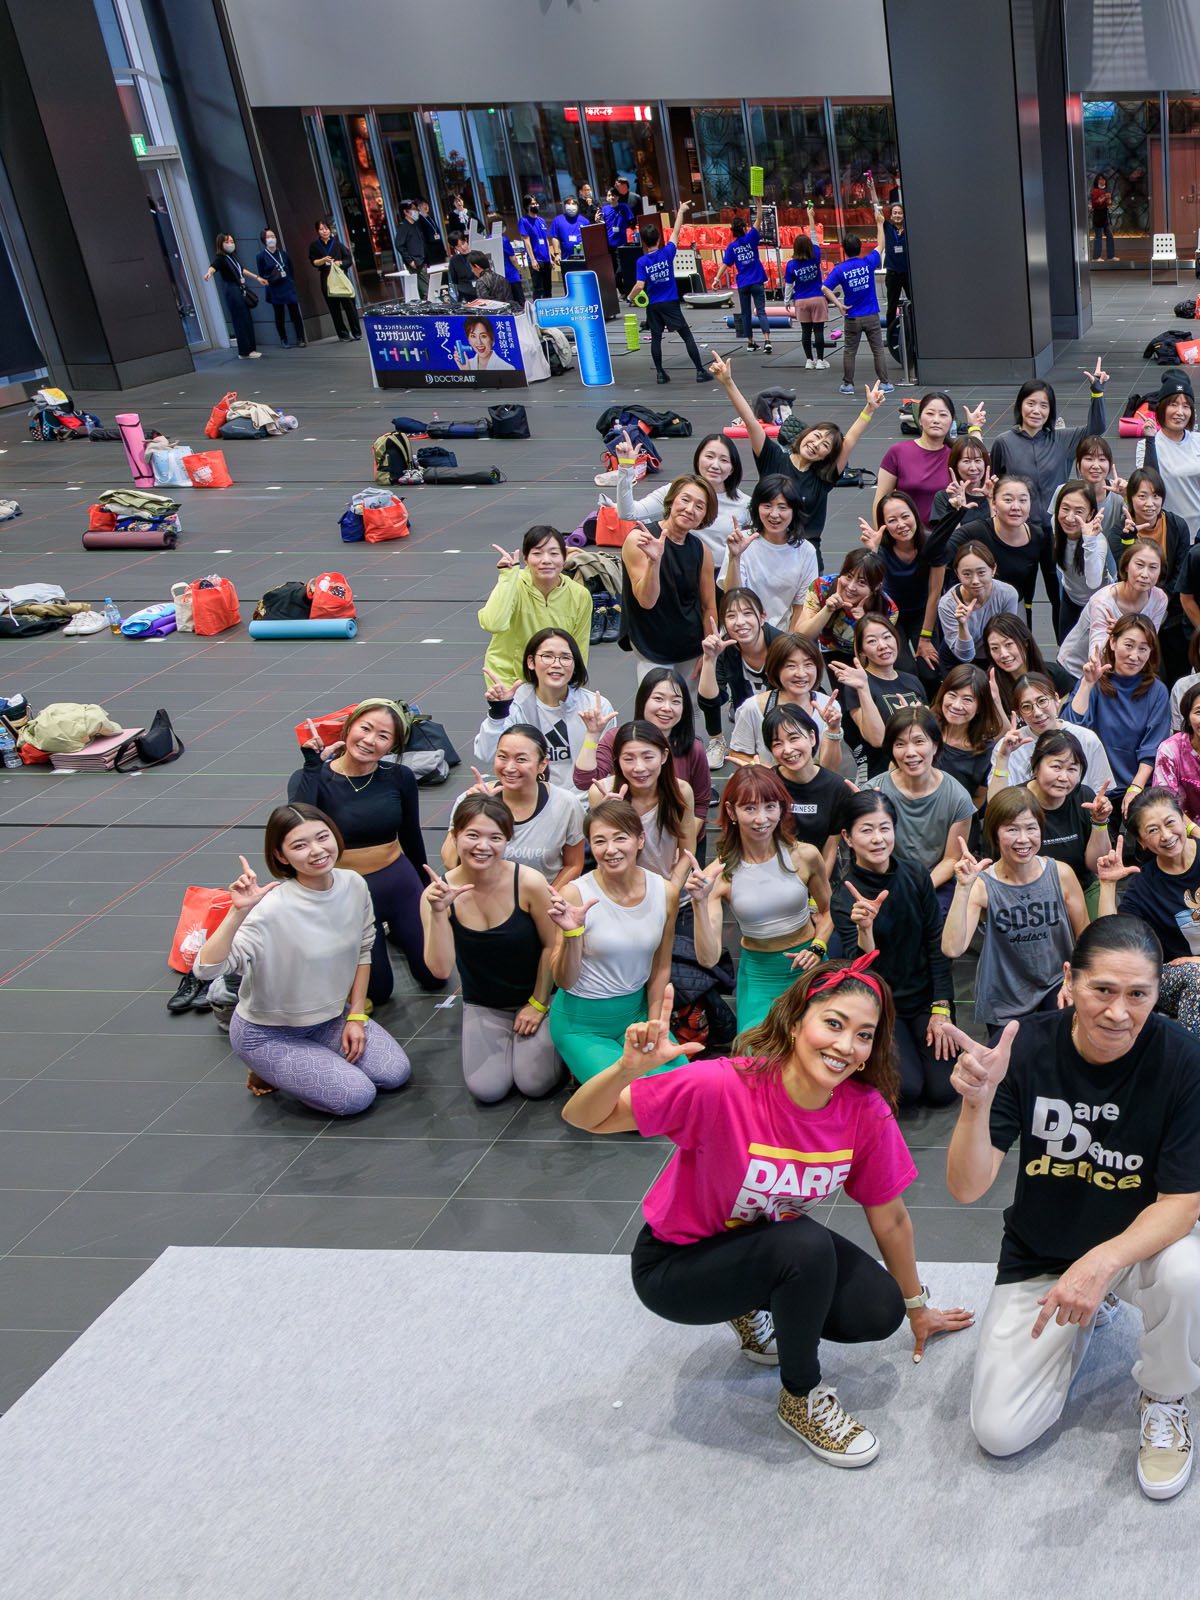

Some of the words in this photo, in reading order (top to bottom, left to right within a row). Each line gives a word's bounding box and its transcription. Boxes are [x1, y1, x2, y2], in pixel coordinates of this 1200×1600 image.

[996, 901, 1059, 934] SDSU
[1031, 1096, 1120, 1141] Dare
[1046, 1122, 1144, 1171] Demo
[742, 1159, 851, 1197] DARE
[1025, 1154, 1142, 1190] dance
